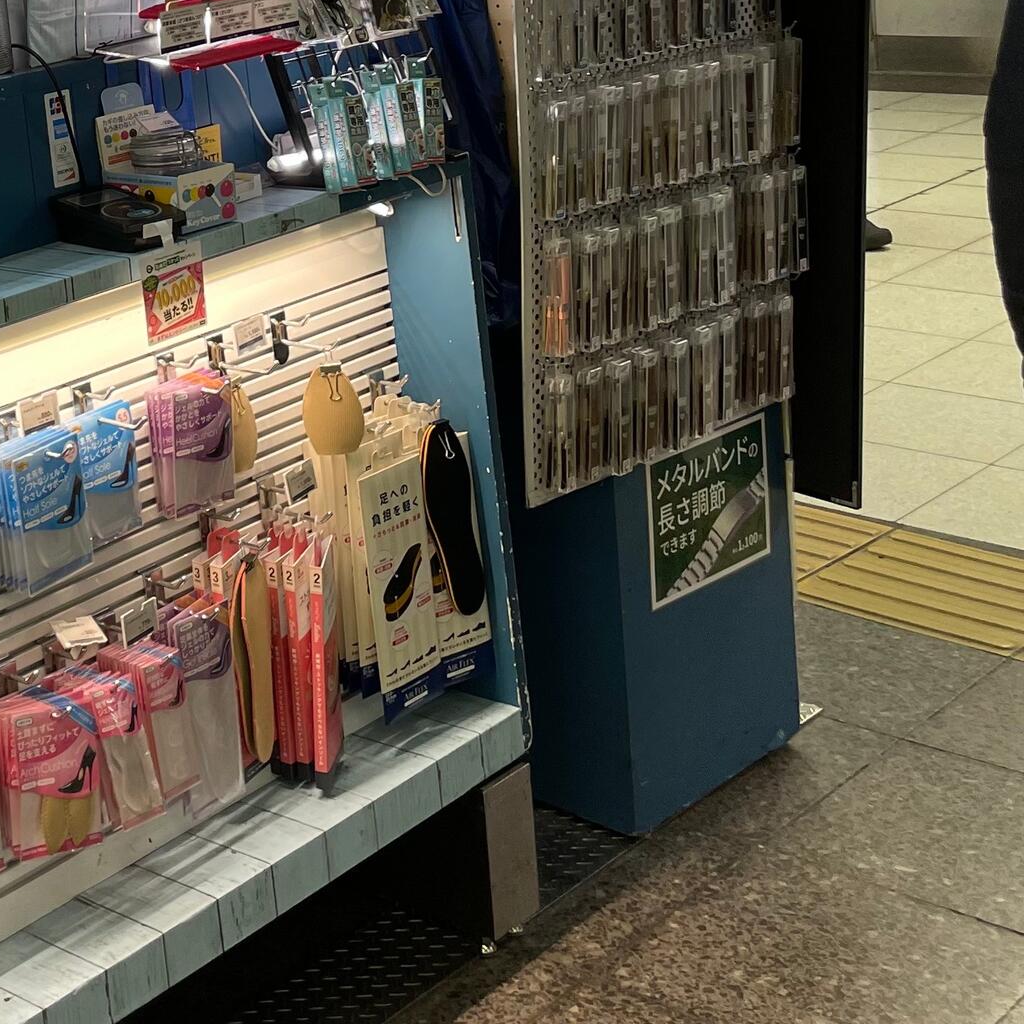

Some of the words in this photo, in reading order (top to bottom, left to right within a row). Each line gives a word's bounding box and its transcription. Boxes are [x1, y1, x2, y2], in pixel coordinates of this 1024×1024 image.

[163, 296, 194, 323] 当たる!!
[80, 441, 123, 464] さしくサポート
[20, 464, 66, 494] ソフトなジェルで
[656, 435, 759, 500] メタルバンドの
[23, 475, 69, 503] やさしくサポート
[379, 484, 408, 506] 足への
[22, 505, 40, 518] Half
[41, 497, 58, 509] Sole
[372, 496, 418, 527] 負担を軽く
[658, 480, 725, 536] 長さ調節
[660, 528, 697, 556] できます
[213, 572, 219, 582] 3
[268, 567, 276, 578] 2
[286, 570, 292, 581] 2
[313, 573, 320, 584] 2
[17, 727, 79, 751] ぴったりフィットで
